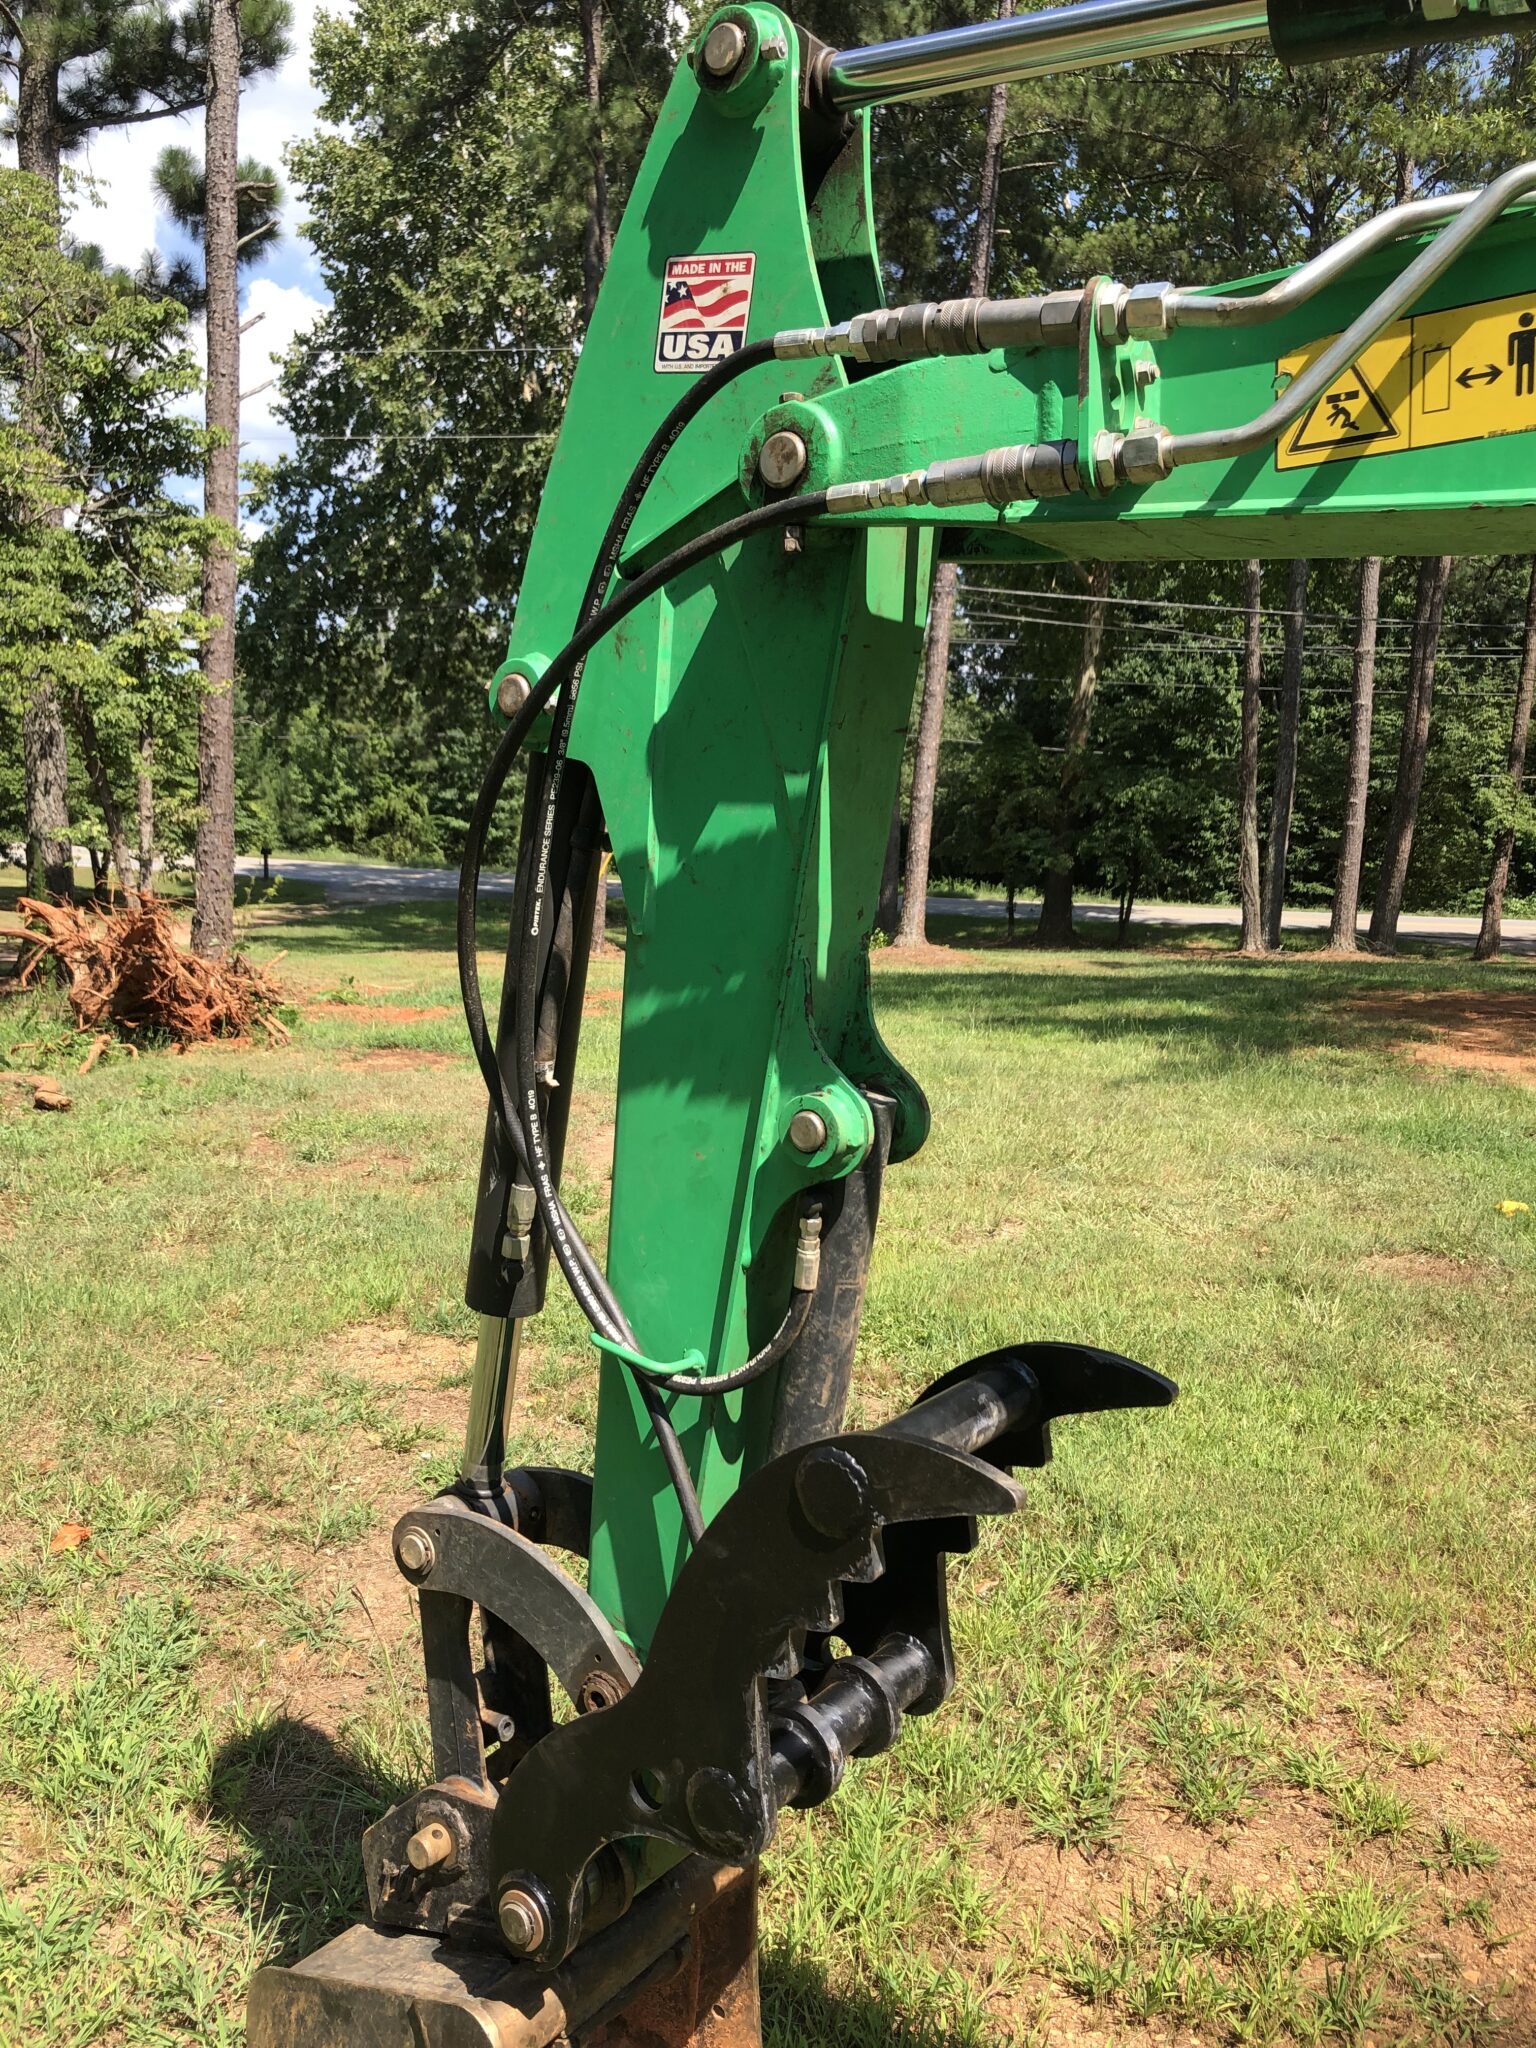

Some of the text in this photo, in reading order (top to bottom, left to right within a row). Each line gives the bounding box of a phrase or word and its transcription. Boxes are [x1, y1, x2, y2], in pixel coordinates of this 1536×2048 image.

[672, 260, 748, 276] MADE IN THE
[662, 333, 735, 360] USA
[535, 838, 551, 893] ENDURANCE
[543, 804, 555, 836] SERIES
[549, 759, 563, 800] PE239-06
[557, 738, 567, 756] 3/8"
[573, 662, 584, 678] PSI
[608, 534, 625, 561] MSHA
[620, 505, 637, 530] FRAS
[640, 474, 650, 488] HF
[647, 451, 665, 473] TYPE
[661, 443, 670, 451] B
[527, 1089, 536, 1110] 4Q19
[530, 1113, 538, 1121] B
[530, 1121, 541, 1145] TYPE
[534, 1145, 544, 1158] HF
[540, 1174, 553, 1198] FRAS
[547, 1199, 561, 1227] MSHA
